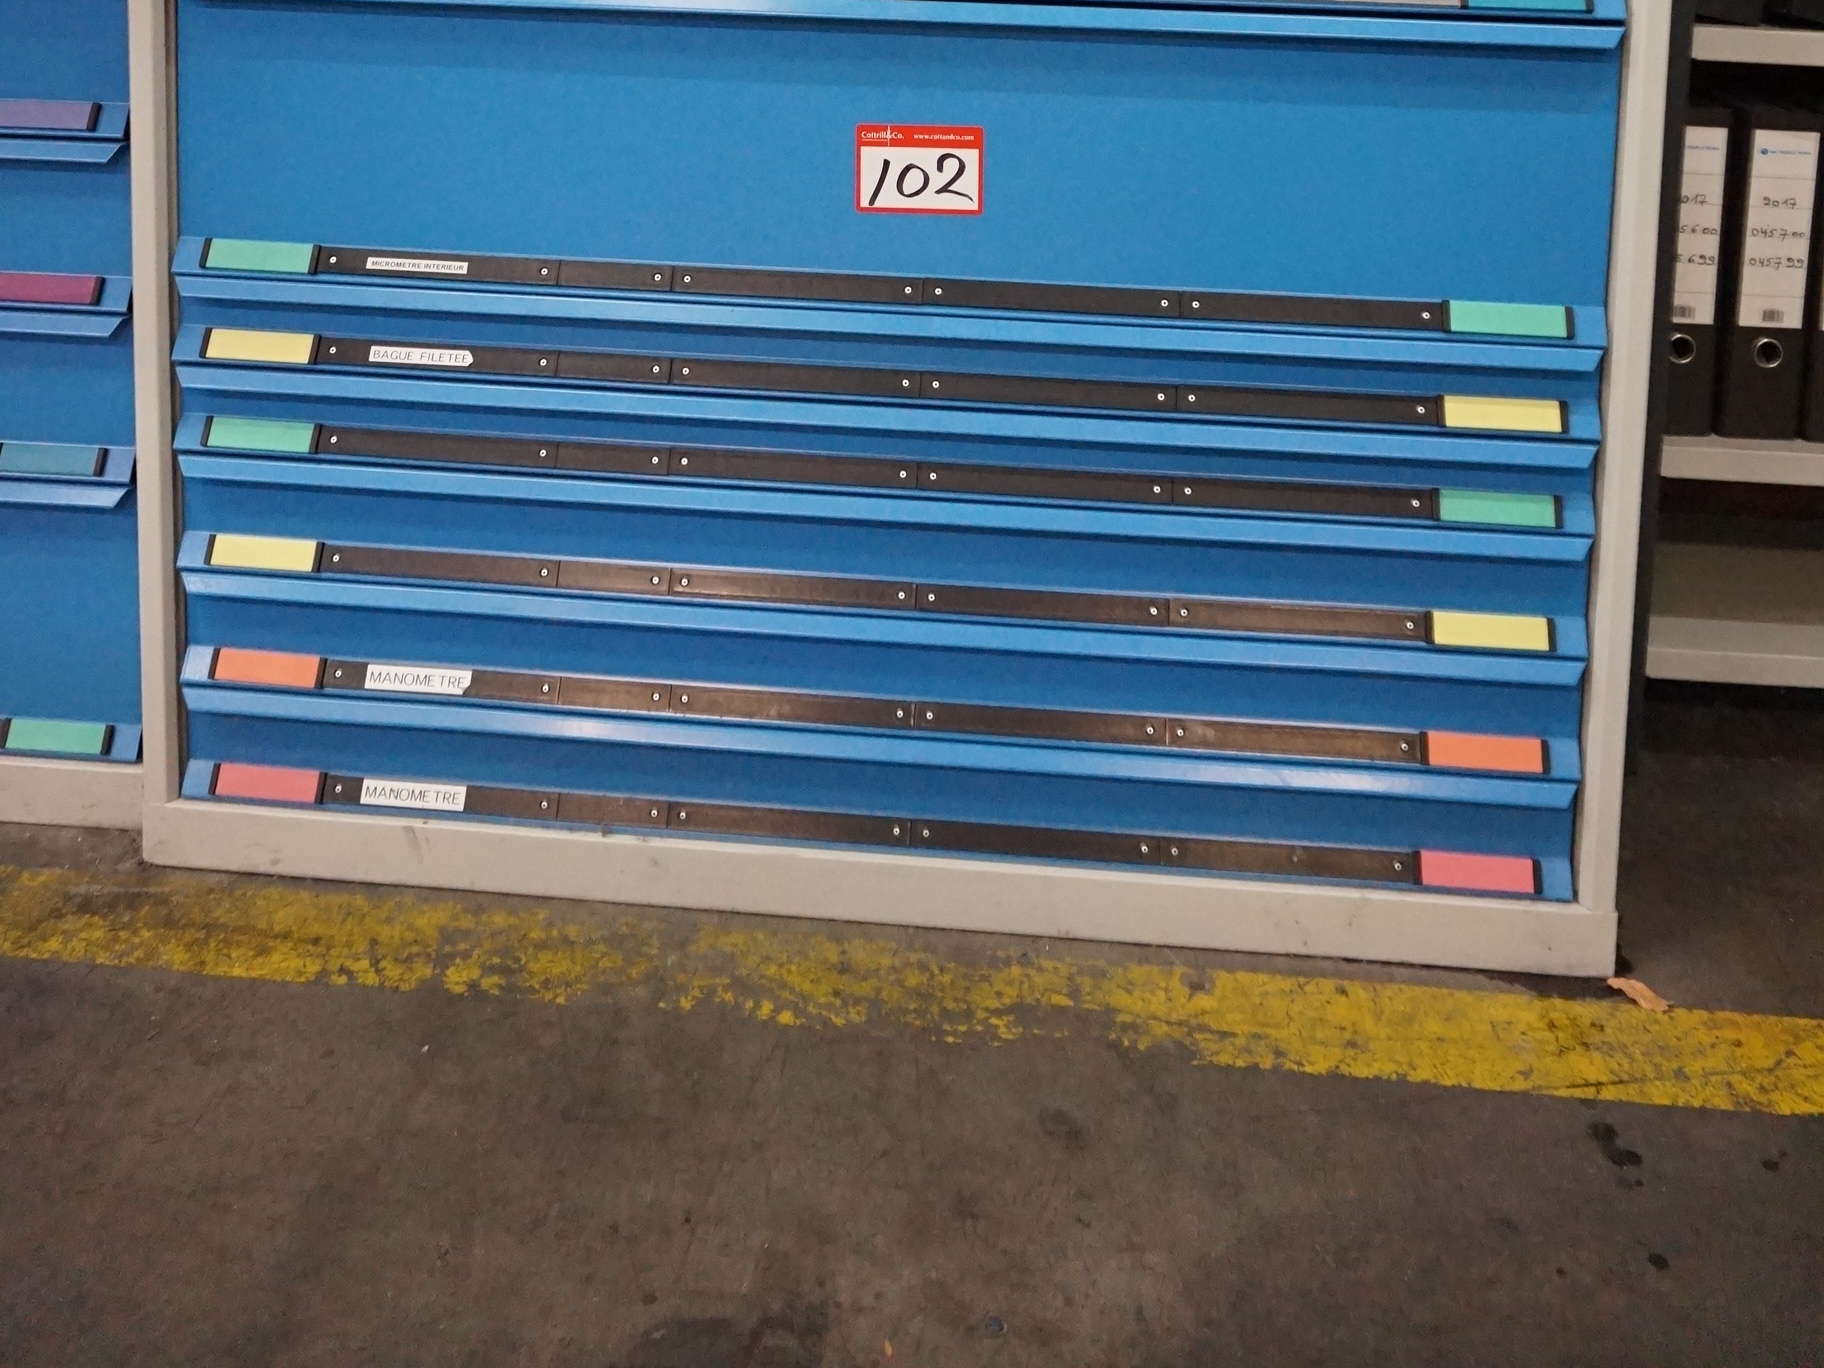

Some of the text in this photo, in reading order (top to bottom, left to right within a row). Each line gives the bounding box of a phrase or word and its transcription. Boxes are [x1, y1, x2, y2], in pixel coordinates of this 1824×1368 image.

[913, 133, 975, 141] www.cottandco.com
[868, 152, 975, 207] 102
[1762, 195, 1798, 209] 2017
[371, 260, 465, 271] MICROMETRE INTERIEUR
[1748, 256, 1805, 271] 045799
[373, 349, 470, 364] BAGUE FILETEE
[368, 671, 467, 689] MANOMETRE
[364, 785, 462, 806] MANOMETRE
